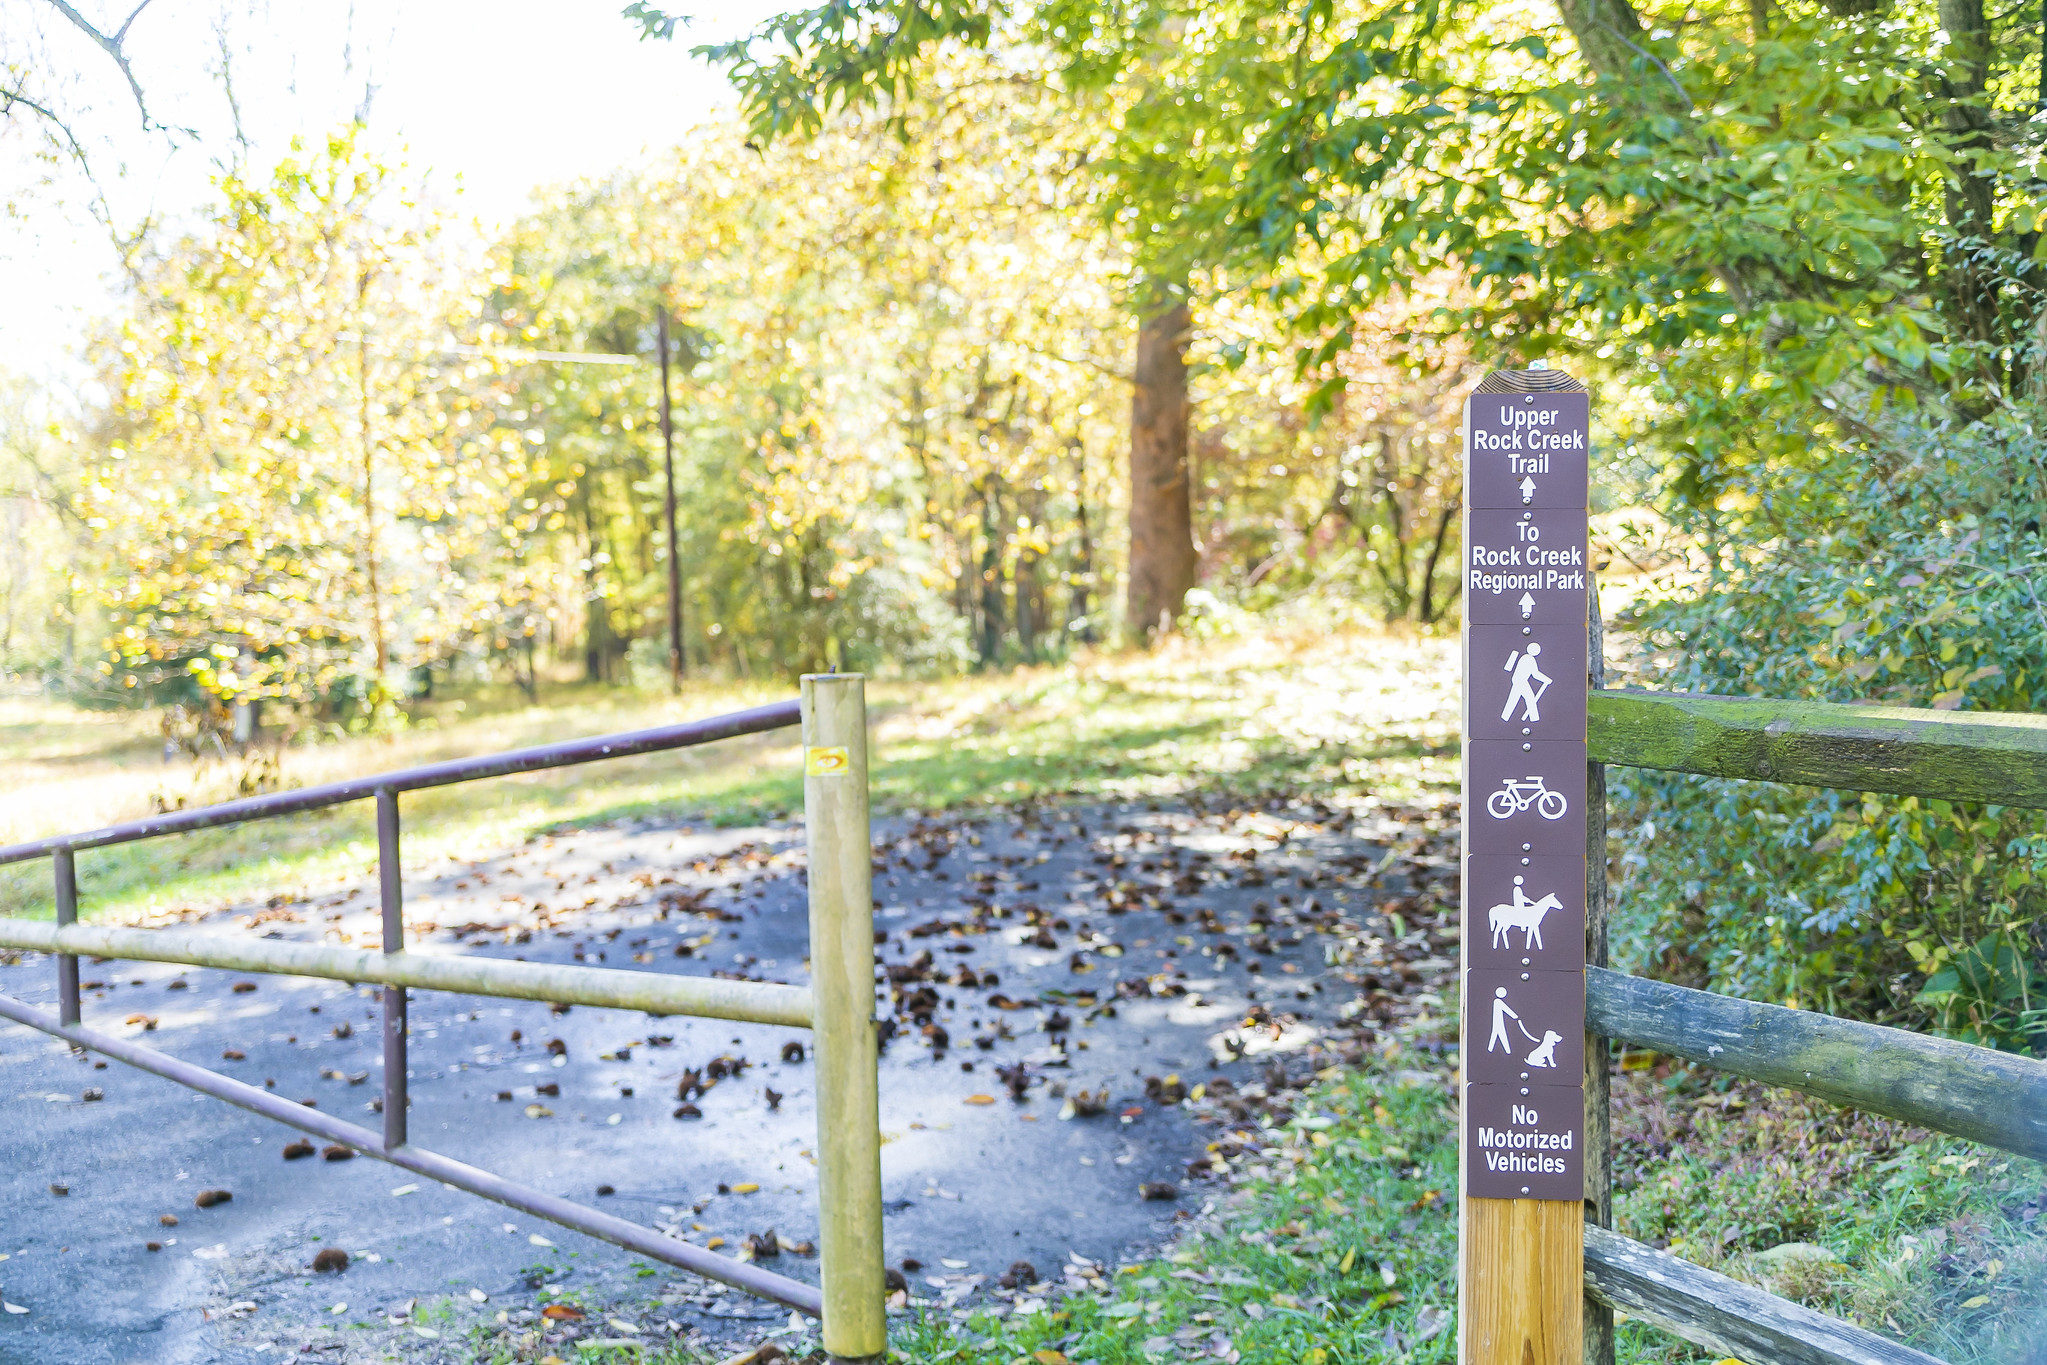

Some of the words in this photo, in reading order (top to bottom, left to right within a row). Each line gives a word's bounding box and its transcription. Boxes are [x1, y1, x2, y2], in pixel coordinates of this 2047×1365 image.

[1500, 405, 1559, 430] Upper
[1474, 429, 1523, 450] Rock
[1527, 429, 1584, 450] Creek
[1508, 453, 1549, 474] Trail
[1516, 521, 1540, 542] To
[1472, 545, 1521, 566] Rock
[1526, 546, 1582, 566] Creek
[1470, 569, 1543, 594] Regional
[1546, 570, 1584, 590] Park
[1512, 1104, 1538, 1125] No
[1478, 1127, 1572, 1150] Motorized
[1485, 1151, 1566, 1174] Vehicles
